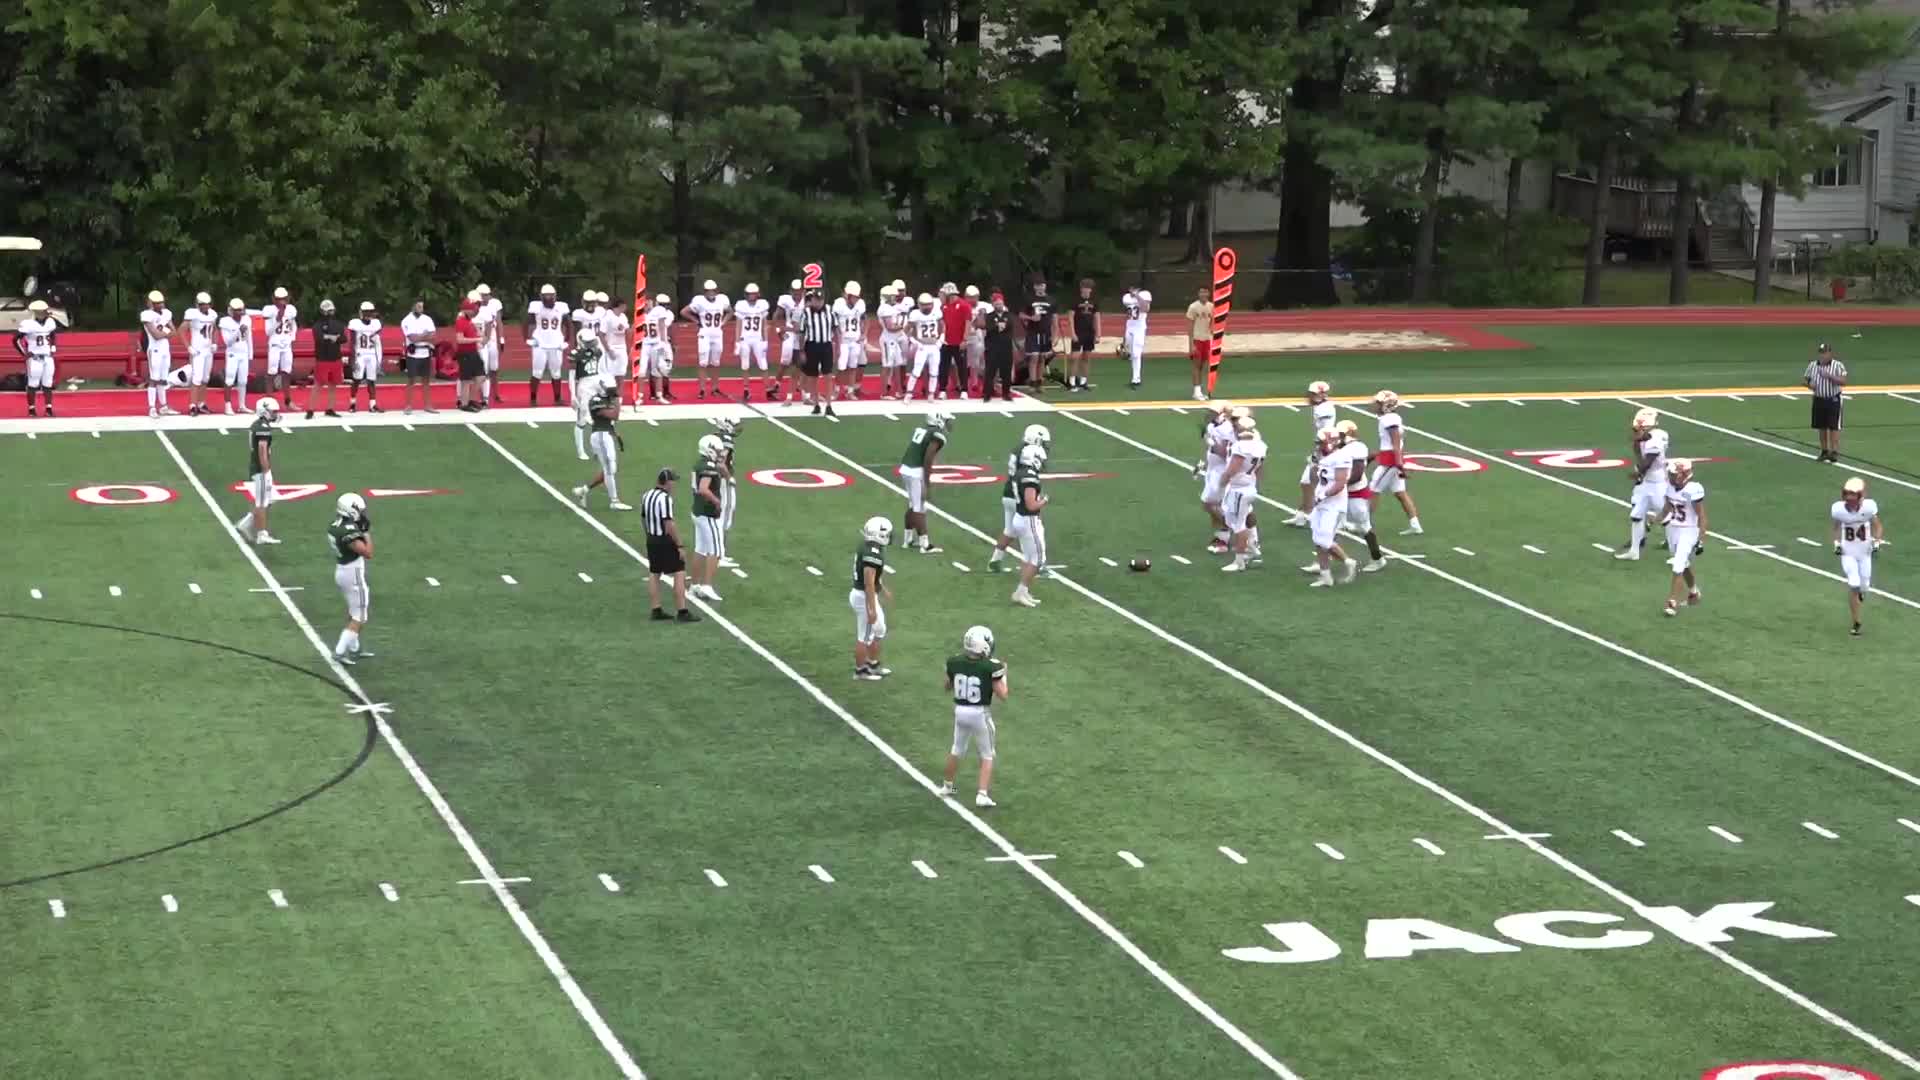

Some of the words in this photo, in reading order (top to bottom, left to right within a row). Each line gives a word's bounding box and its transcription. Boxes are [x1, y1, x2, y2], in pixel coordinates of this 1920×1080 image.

[1218, 251, 1233, 271] 0
[803, 263, 823, 289] 2
[705, 312, 721, 328] 98
[744, 316, 760, 331] 39
[846, 317, 858, 332] 19
[921, 323, 936, 338] 22
[1845, 523, 1866, 542] 84
[954, 673, 981, 704] 86
[1221, 901, 1837, 963] JACK
